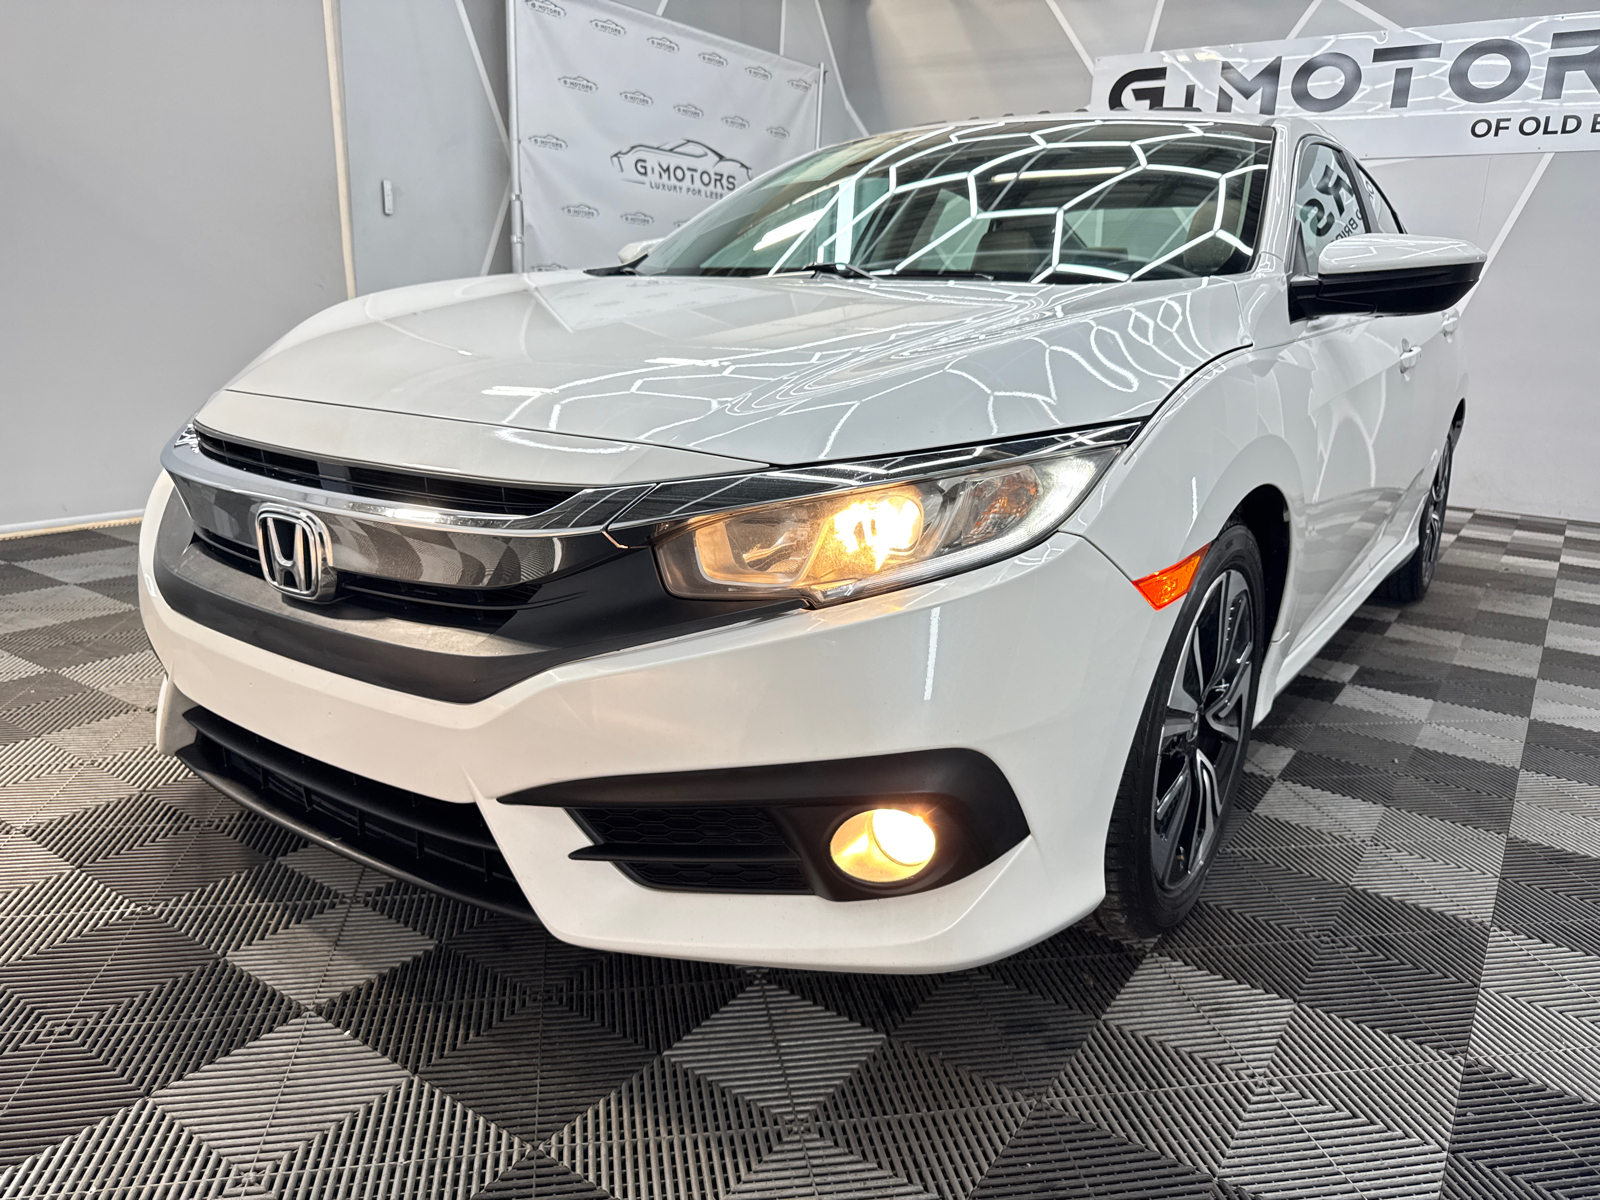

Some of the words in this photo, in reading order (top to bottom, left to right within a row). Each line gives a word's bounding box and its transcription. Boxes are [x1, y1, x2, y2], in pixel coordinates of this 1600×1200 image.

[1470, 117, 1512, 138] OF
[1518, 114, 1582, 136] OLD
[658, 160, 737, 191] MOTORS
[650, 181, 683, 194] LUXURY
[686, 187, 702, 197] FOR
